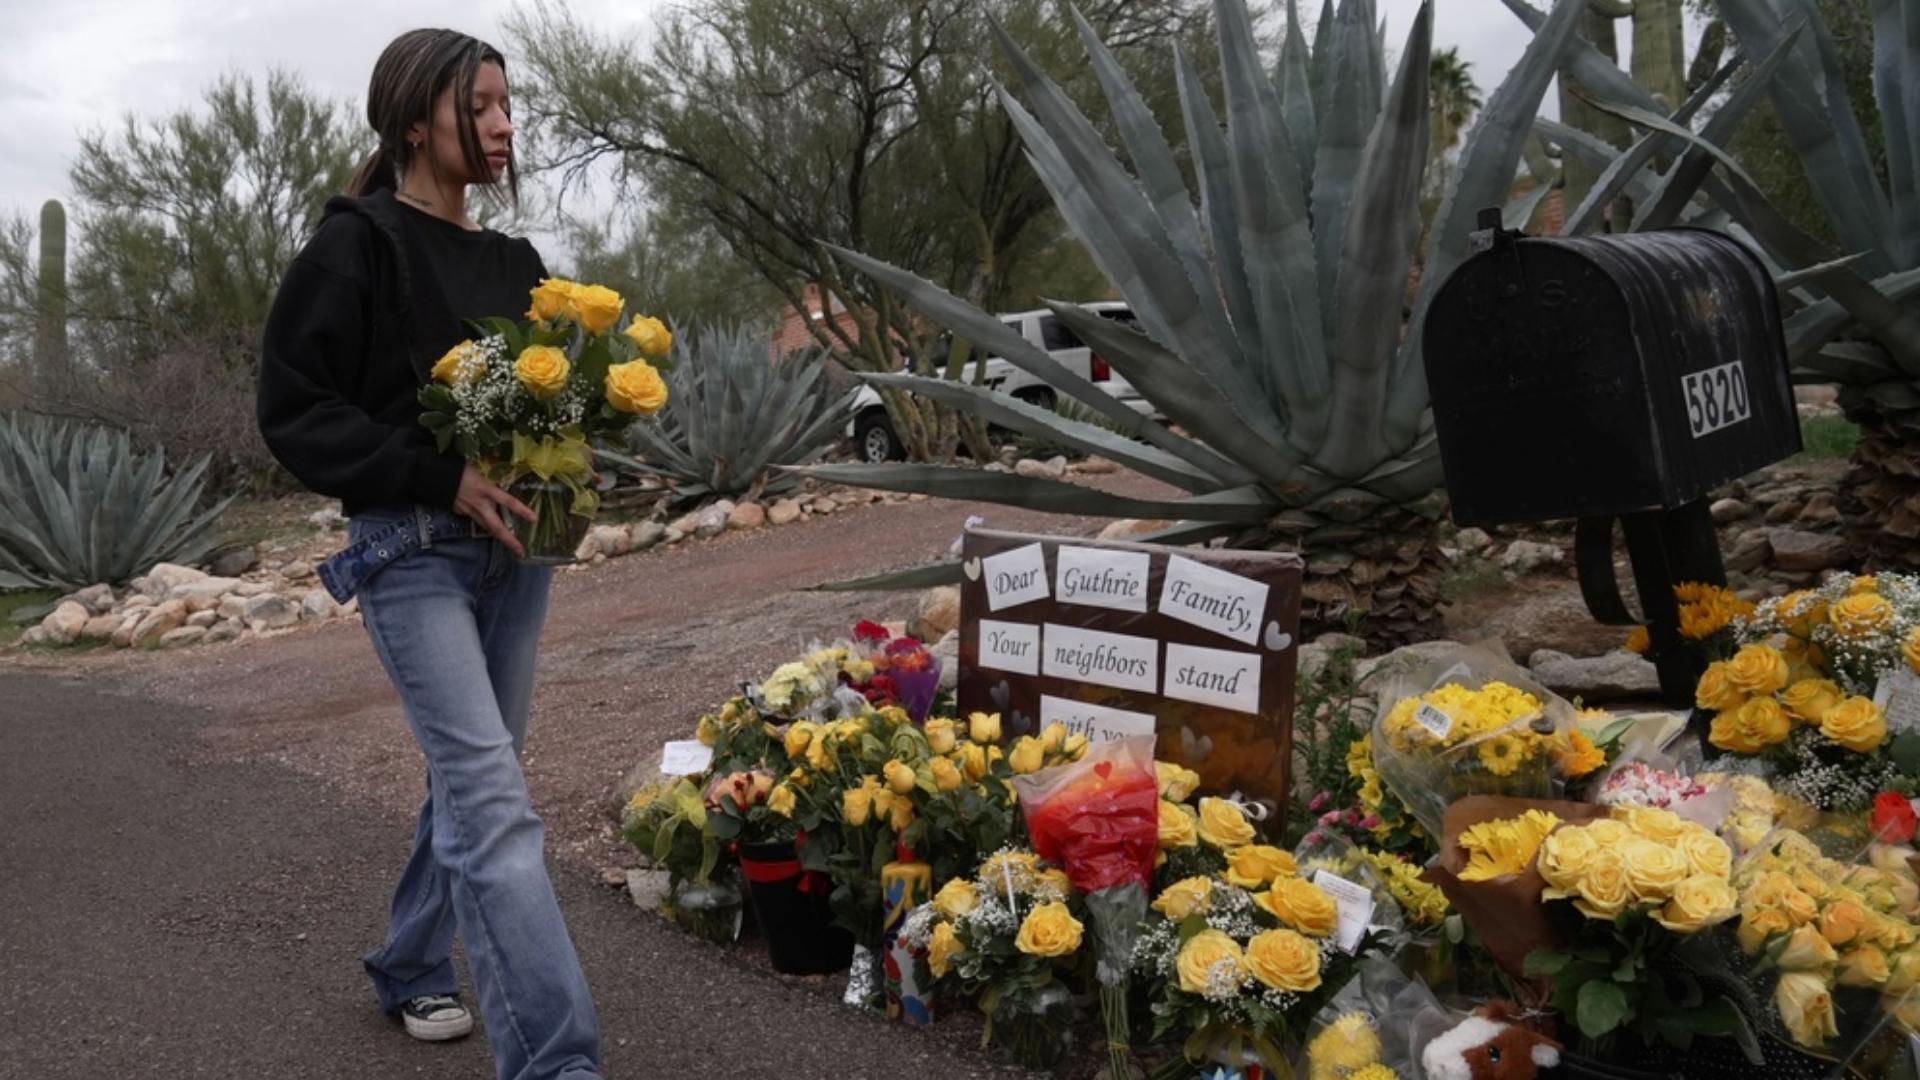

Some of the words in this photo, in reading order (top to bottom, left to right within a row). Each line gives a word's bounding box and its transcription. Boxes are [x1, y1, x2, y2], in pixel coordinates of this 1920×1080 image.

[1686, 364, 1747, 433] 5820
[994, 568, 1039, 595] Dear
[1064, 567, 1140, 598] Guthrie
[1170, 578, 1252, 632] Family,
[988, 630, 1032, 657] Your
[1055, 643, 1148, 677] neighbors
[1175, 665, 1248, 695] stand
